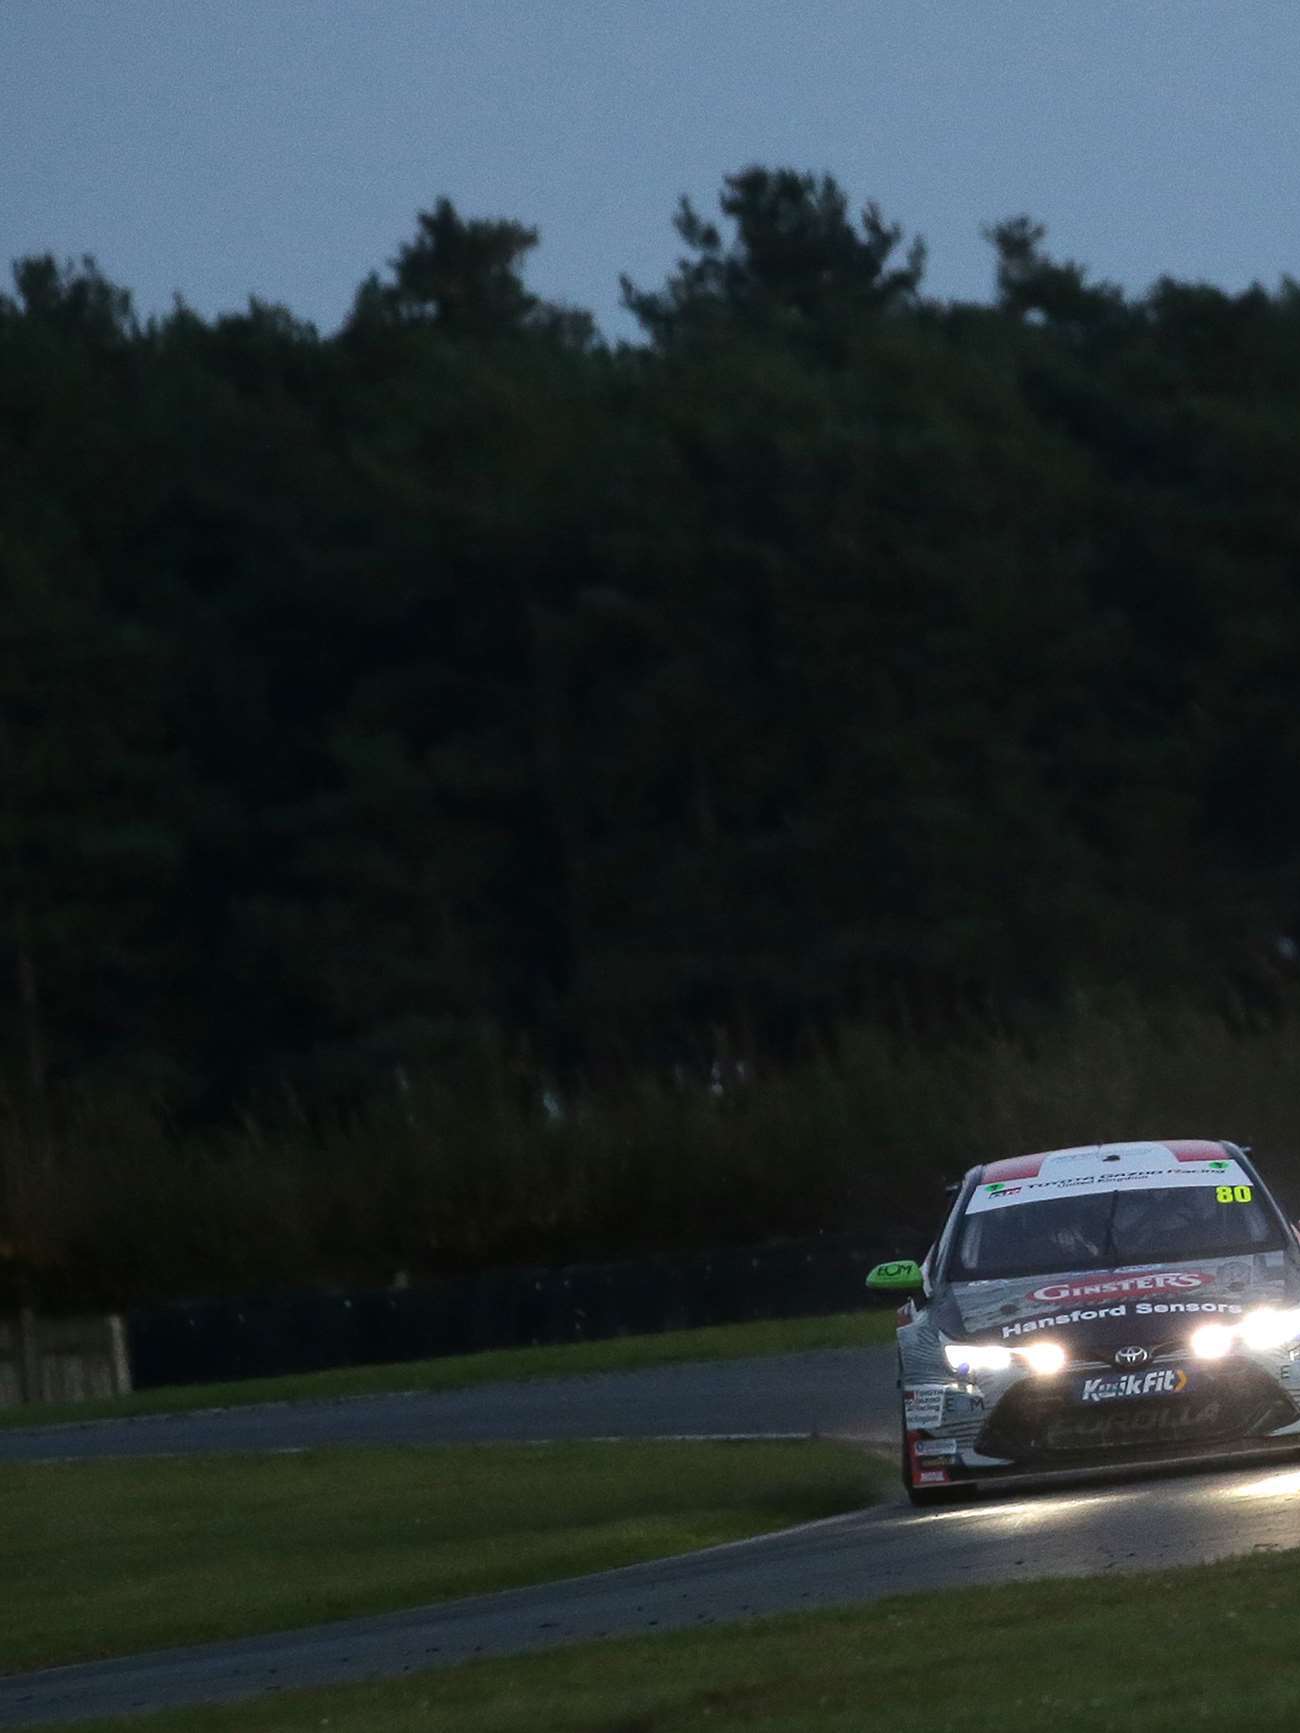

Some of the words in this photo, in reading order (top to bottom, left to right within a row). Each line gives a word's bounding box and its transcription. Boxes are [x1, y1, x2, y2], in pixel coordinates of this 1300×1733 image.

[1215, 1185, 1252, 1204] 80
[1001, 1304, 1127, 1339] Hansford
[1136, 1302, 1243, 1315] Sensors
